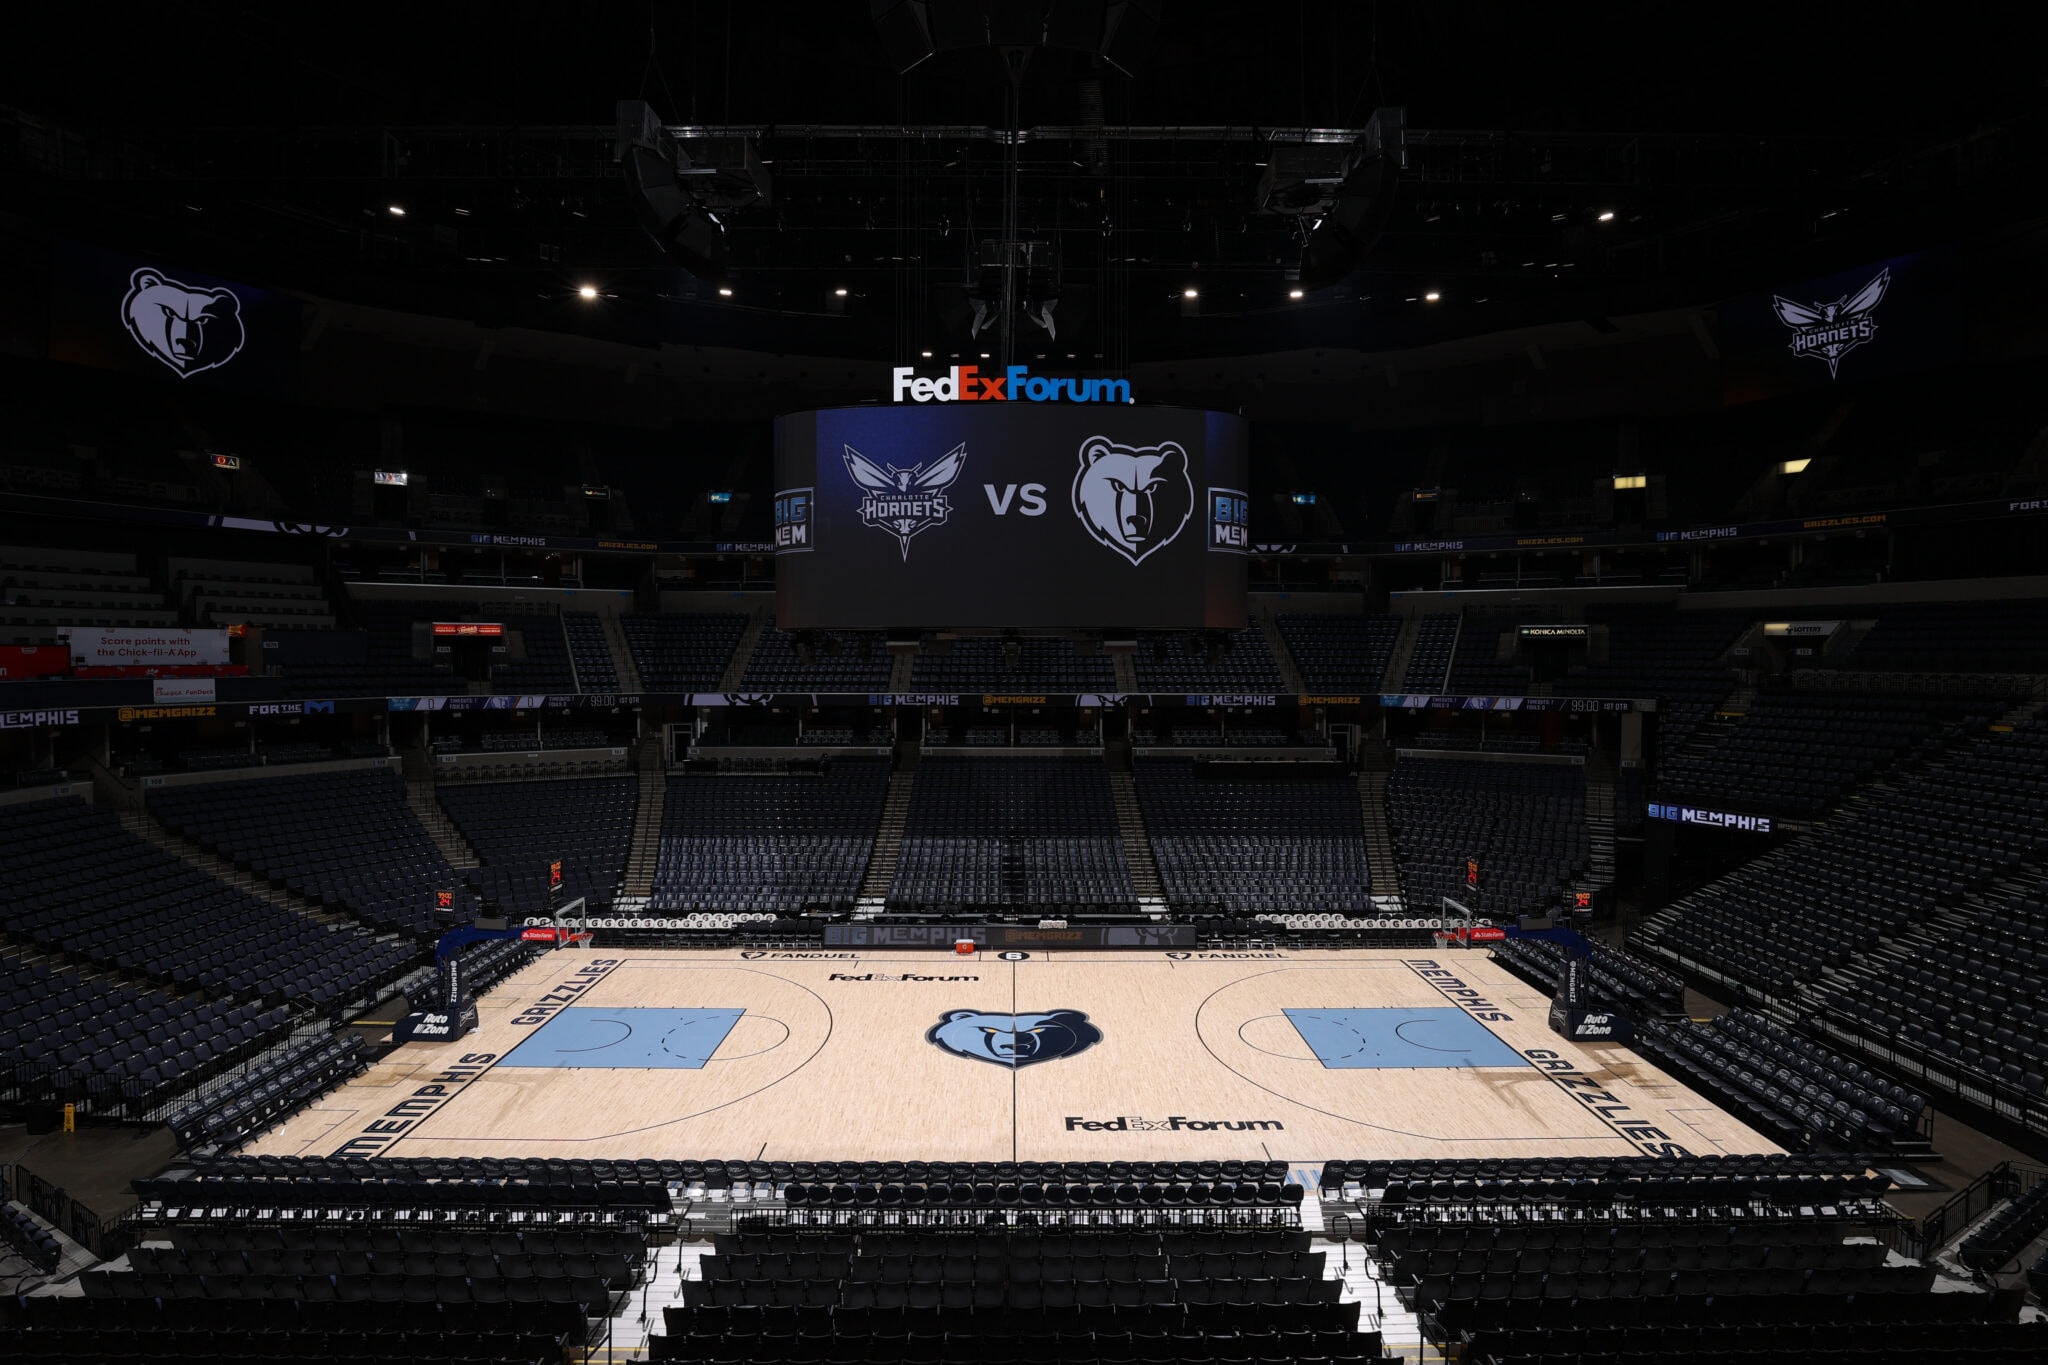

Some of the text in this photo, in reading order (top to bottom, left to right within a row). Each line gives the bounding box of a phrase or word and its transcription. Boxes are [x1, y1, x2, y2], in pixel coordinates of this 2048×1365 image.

[1796, 320, 1871, 352] HORNETS
[983, 483, 1048, 516] VS
[866, 499, 944, 520] HORNETS
[1803, 514, 1887, 529] GRIZZLIES.COM
[1681, 527, 1737, 541] MEMPHIS
[493, 535, 546, 547] MEMPHIS
[735, 543, 775, 552] MEMPHI
[1414, 541, 1463, 551] MEMPHIS
[101, 637, 190, 648] Score points with
[97, 648, 115, 657] the
[177, 648, 197, 659] App
[868, 695, 959, 706] BIG MEMPHIS
[982, 695, 1047, 705] @MEMGRIZZ
[1186, 695, 1276, 706] BIG MEMPHIS
[118, 706, 216, 722] @MEMGRIZZ
[249, 705, 280, 716] FOR
[281, 704, 302, 714] THE
[0, 710, 79, 729] EMPHIS
[1648, 803, 1770, 833] BIG MEMPHIS
[827, 928, 986, 945] BIG MEMPHIS
[1005, 930, 1083, 943] @MEMGRIZZ
[828, 973, 979, 981] FedExForum
[511, 959, 618, 1026] GRIZZLIES
[1407, 959, 1514, 1023] MEMPHIS
[423, 1013, 448, 1024] Auto
[1584, 1014, 1608, 1024] Auto
[422, 1024, 449, 1035] Zone
[1585, 1025, 1611, 1035] Zone
[325, 1052, 497, 1158] MEMPHIS
[1524, 1048, 1693, 1158] GRIZZLIES
[1065, 1116, 1284, 1131] FedExForum
